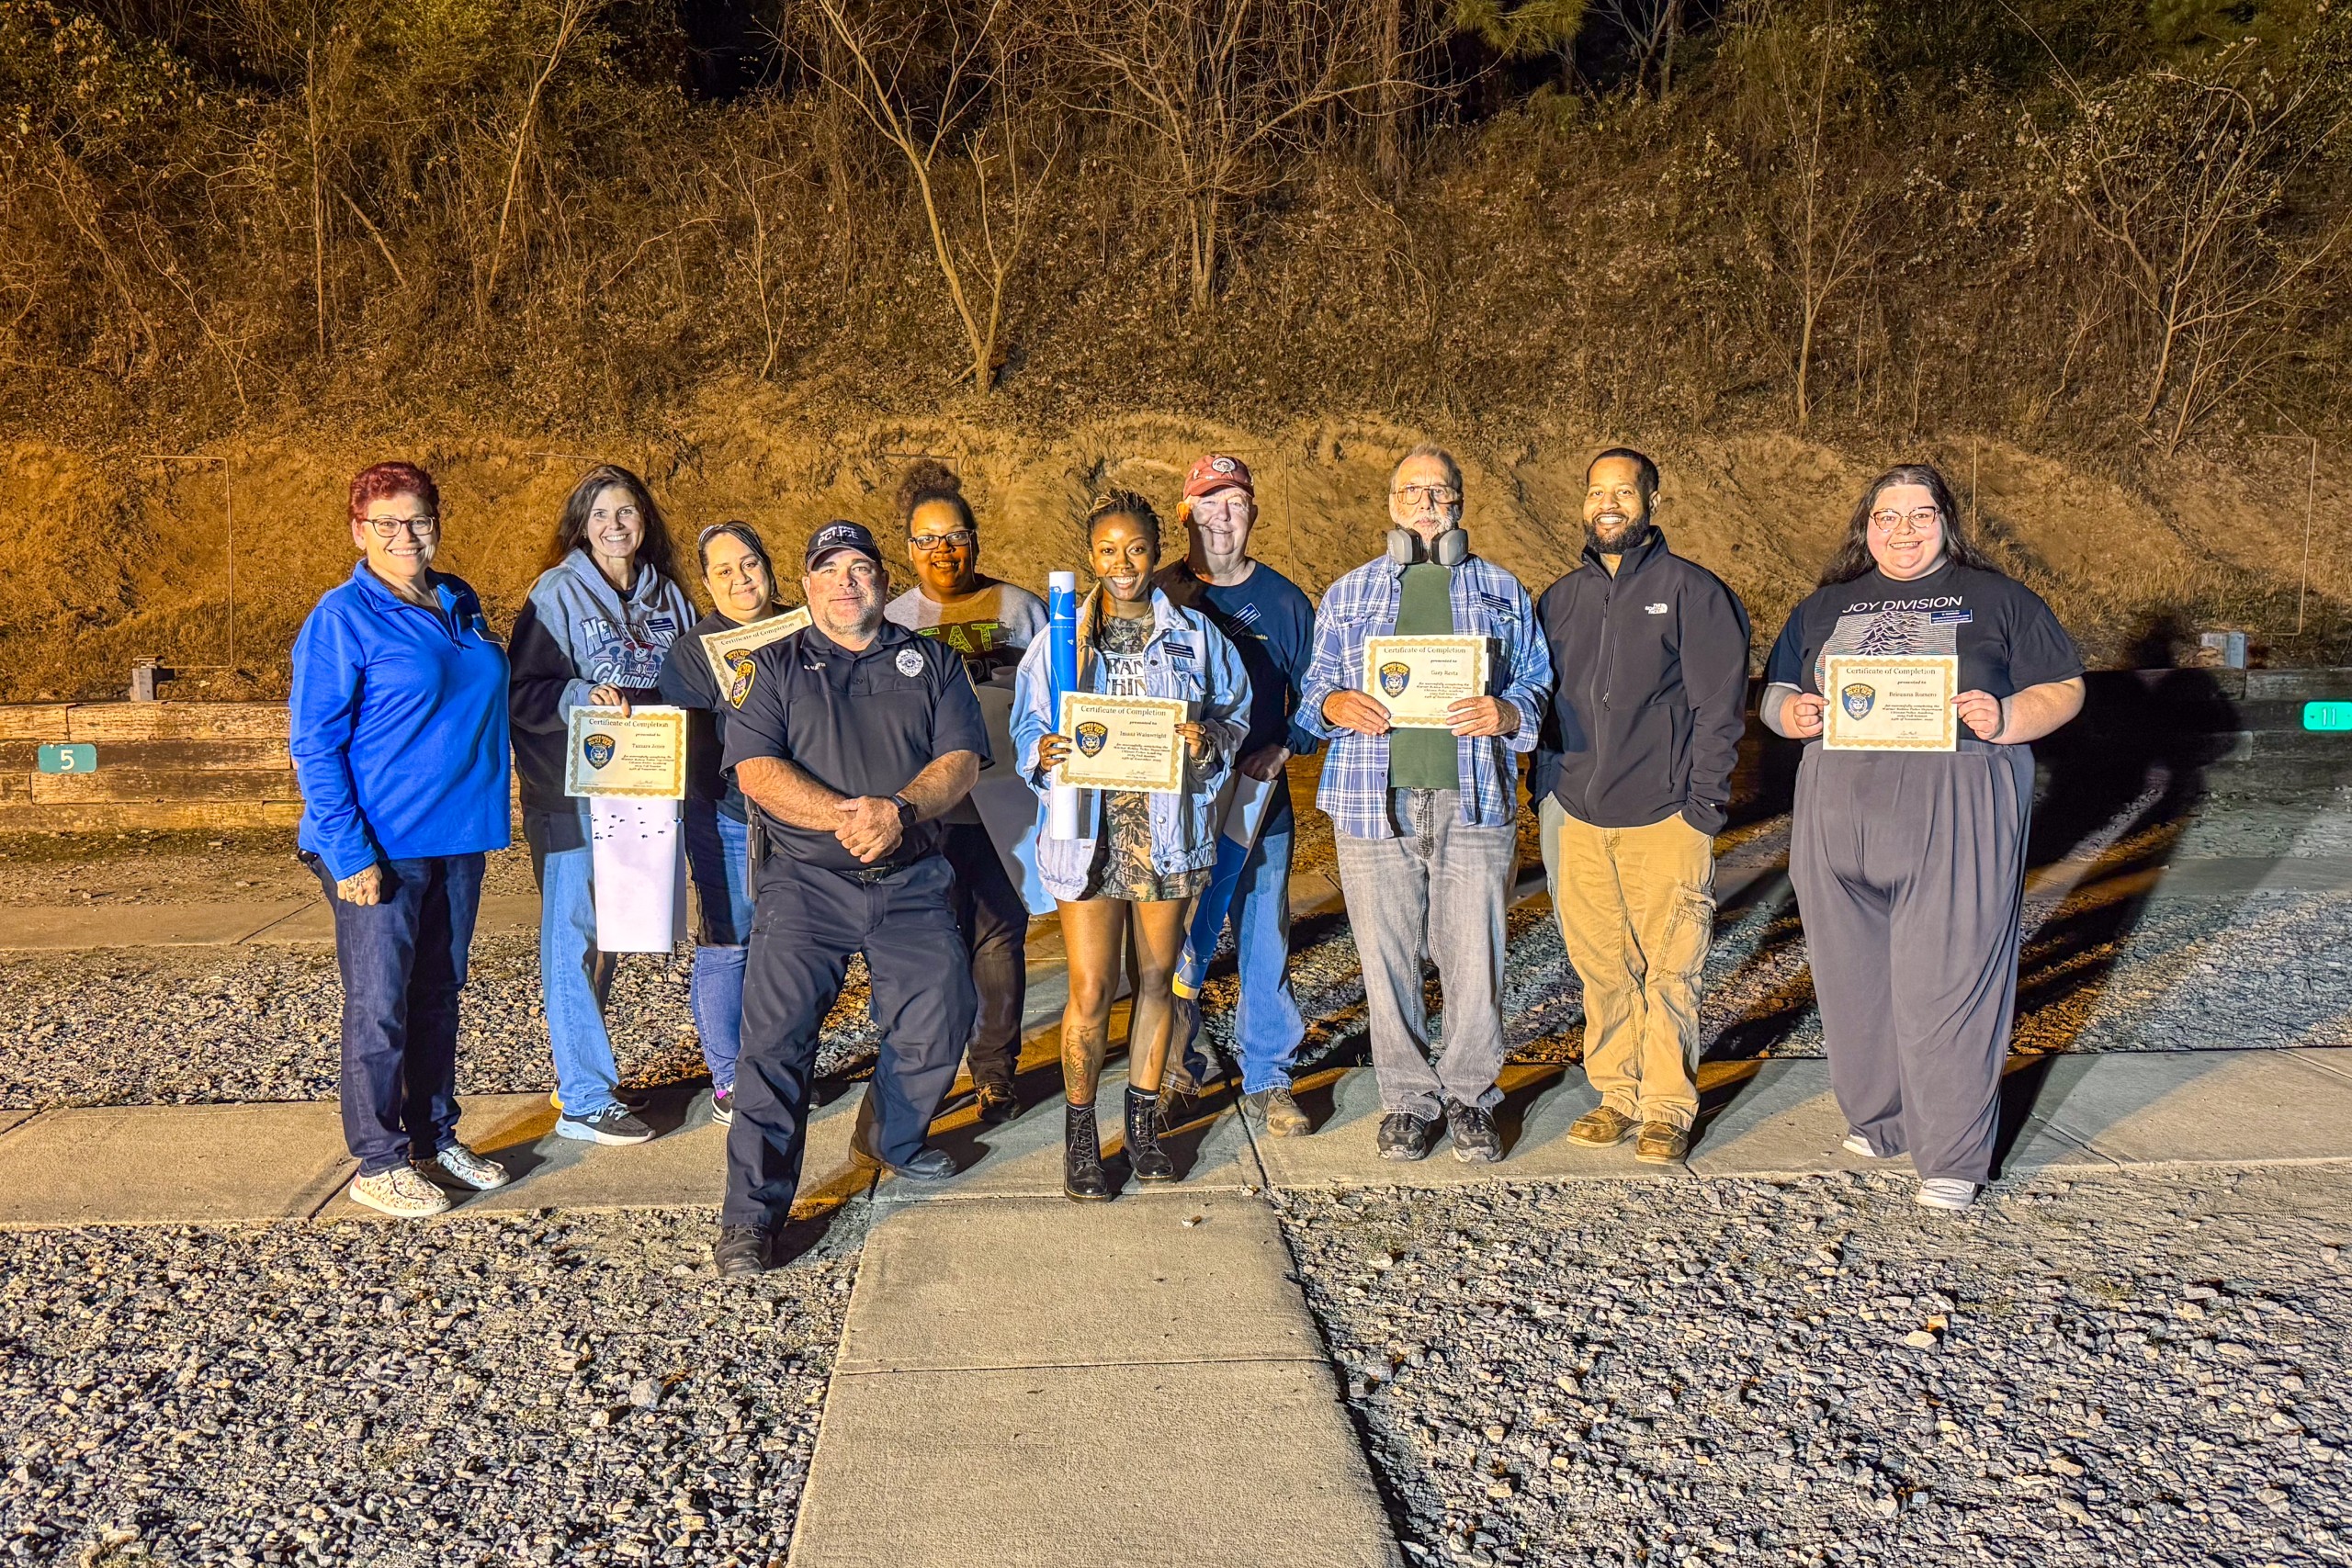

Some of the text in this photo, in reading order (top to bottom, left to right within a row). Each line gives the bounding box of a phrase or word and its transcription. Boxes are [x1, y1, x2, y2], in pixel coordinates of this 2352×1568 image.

[1842, 596, 1962, 613] JOY DIVISION
[720, 634, 752, 646] Certificate
[761, 622, 794, 637] Completion
[918, 623, 998, 653] AT
[1894, 668, 1936, 676] Completion
[1080, 705, 1116, 714] Certificate
[1126, 708, 1166, 716] Completion
[2323, 707, 2335, 726] 11
[589, 718, 623, 727] Certificate
[61, 750, 74, 770] 5
